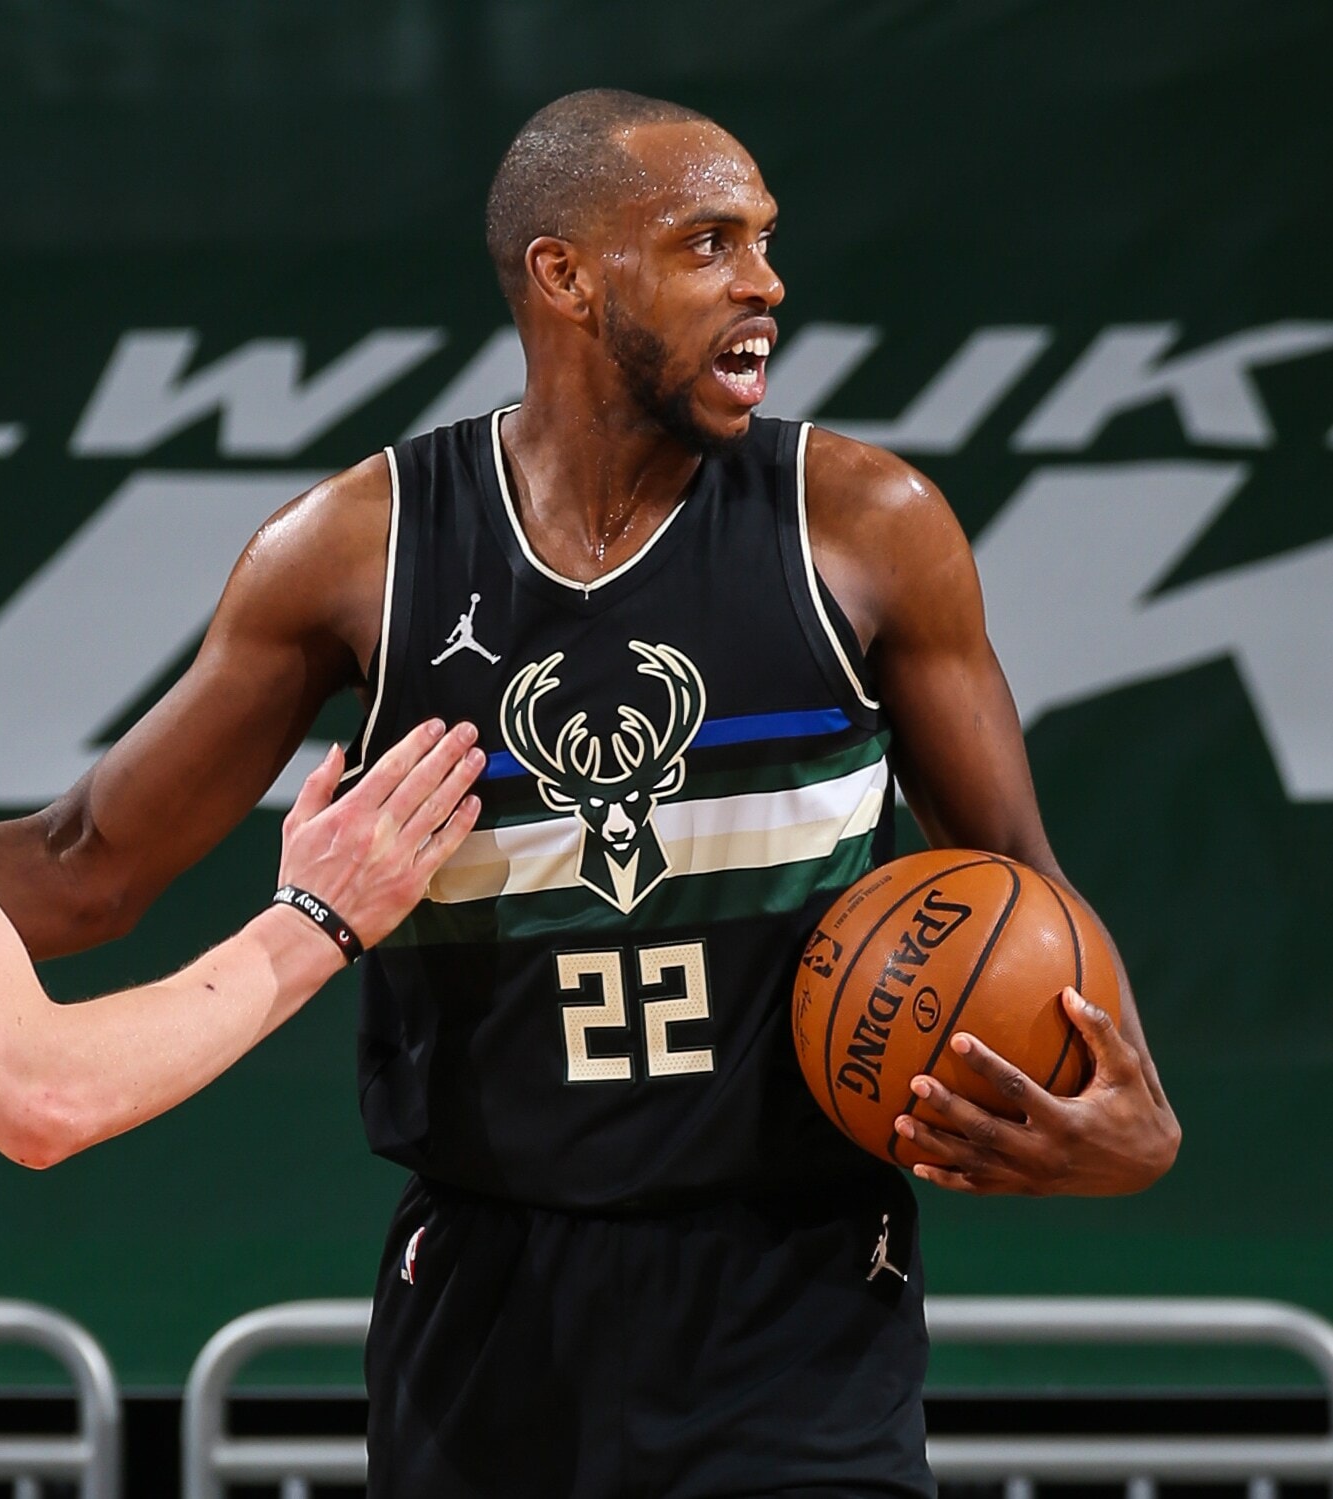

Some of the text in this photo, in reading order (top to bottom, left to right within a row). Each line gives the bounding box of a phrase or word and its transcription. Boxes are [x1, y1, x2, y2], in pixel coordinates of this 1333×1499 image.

[295, 893, 329, 923] Stay
[553, 938, 716, 1084] 22
[836, 889, 972, 1104] SPALDING
